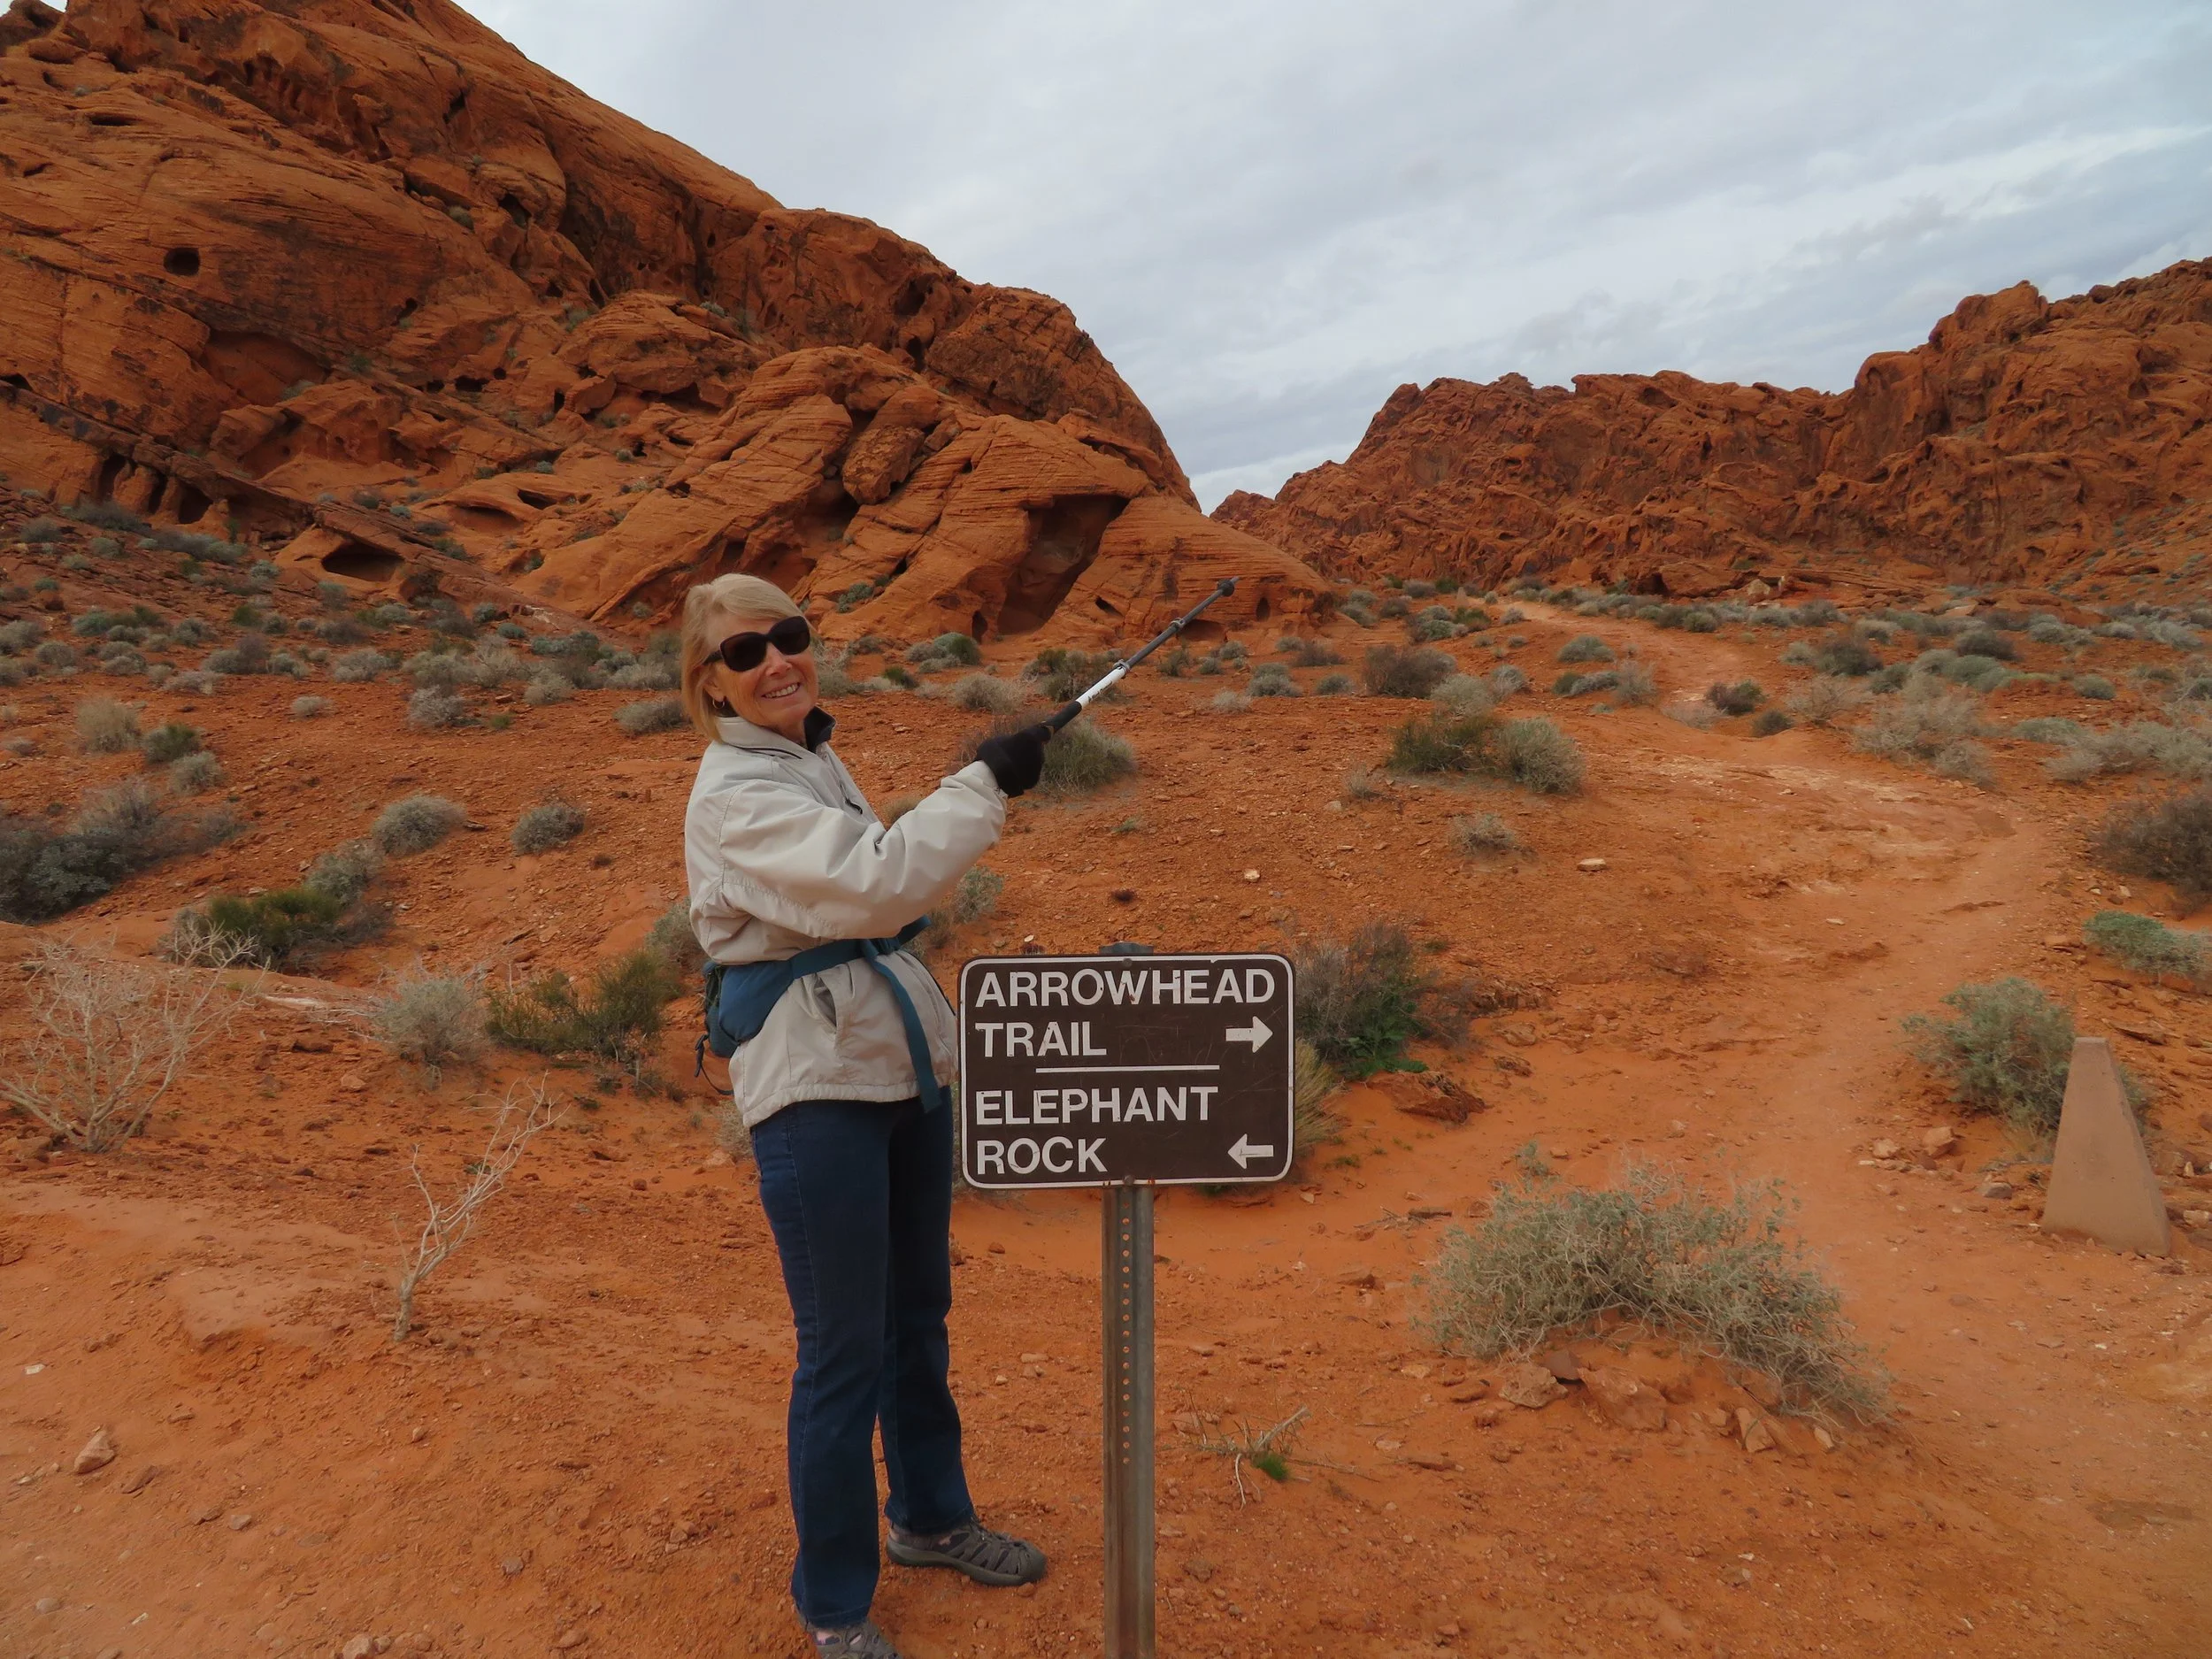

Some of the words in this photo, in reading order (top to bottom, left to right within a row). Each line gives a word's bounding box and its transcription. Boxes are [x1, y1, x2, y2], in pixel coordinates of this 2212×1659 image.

[975, 968, 1275, 1008] ARROWHEAD
[975, 1021, 1107, 1057] TRAIL
[976, 1086, 1218, 1125] ELEPHANT
[977, 1136, 1108, 1175] ROCK
